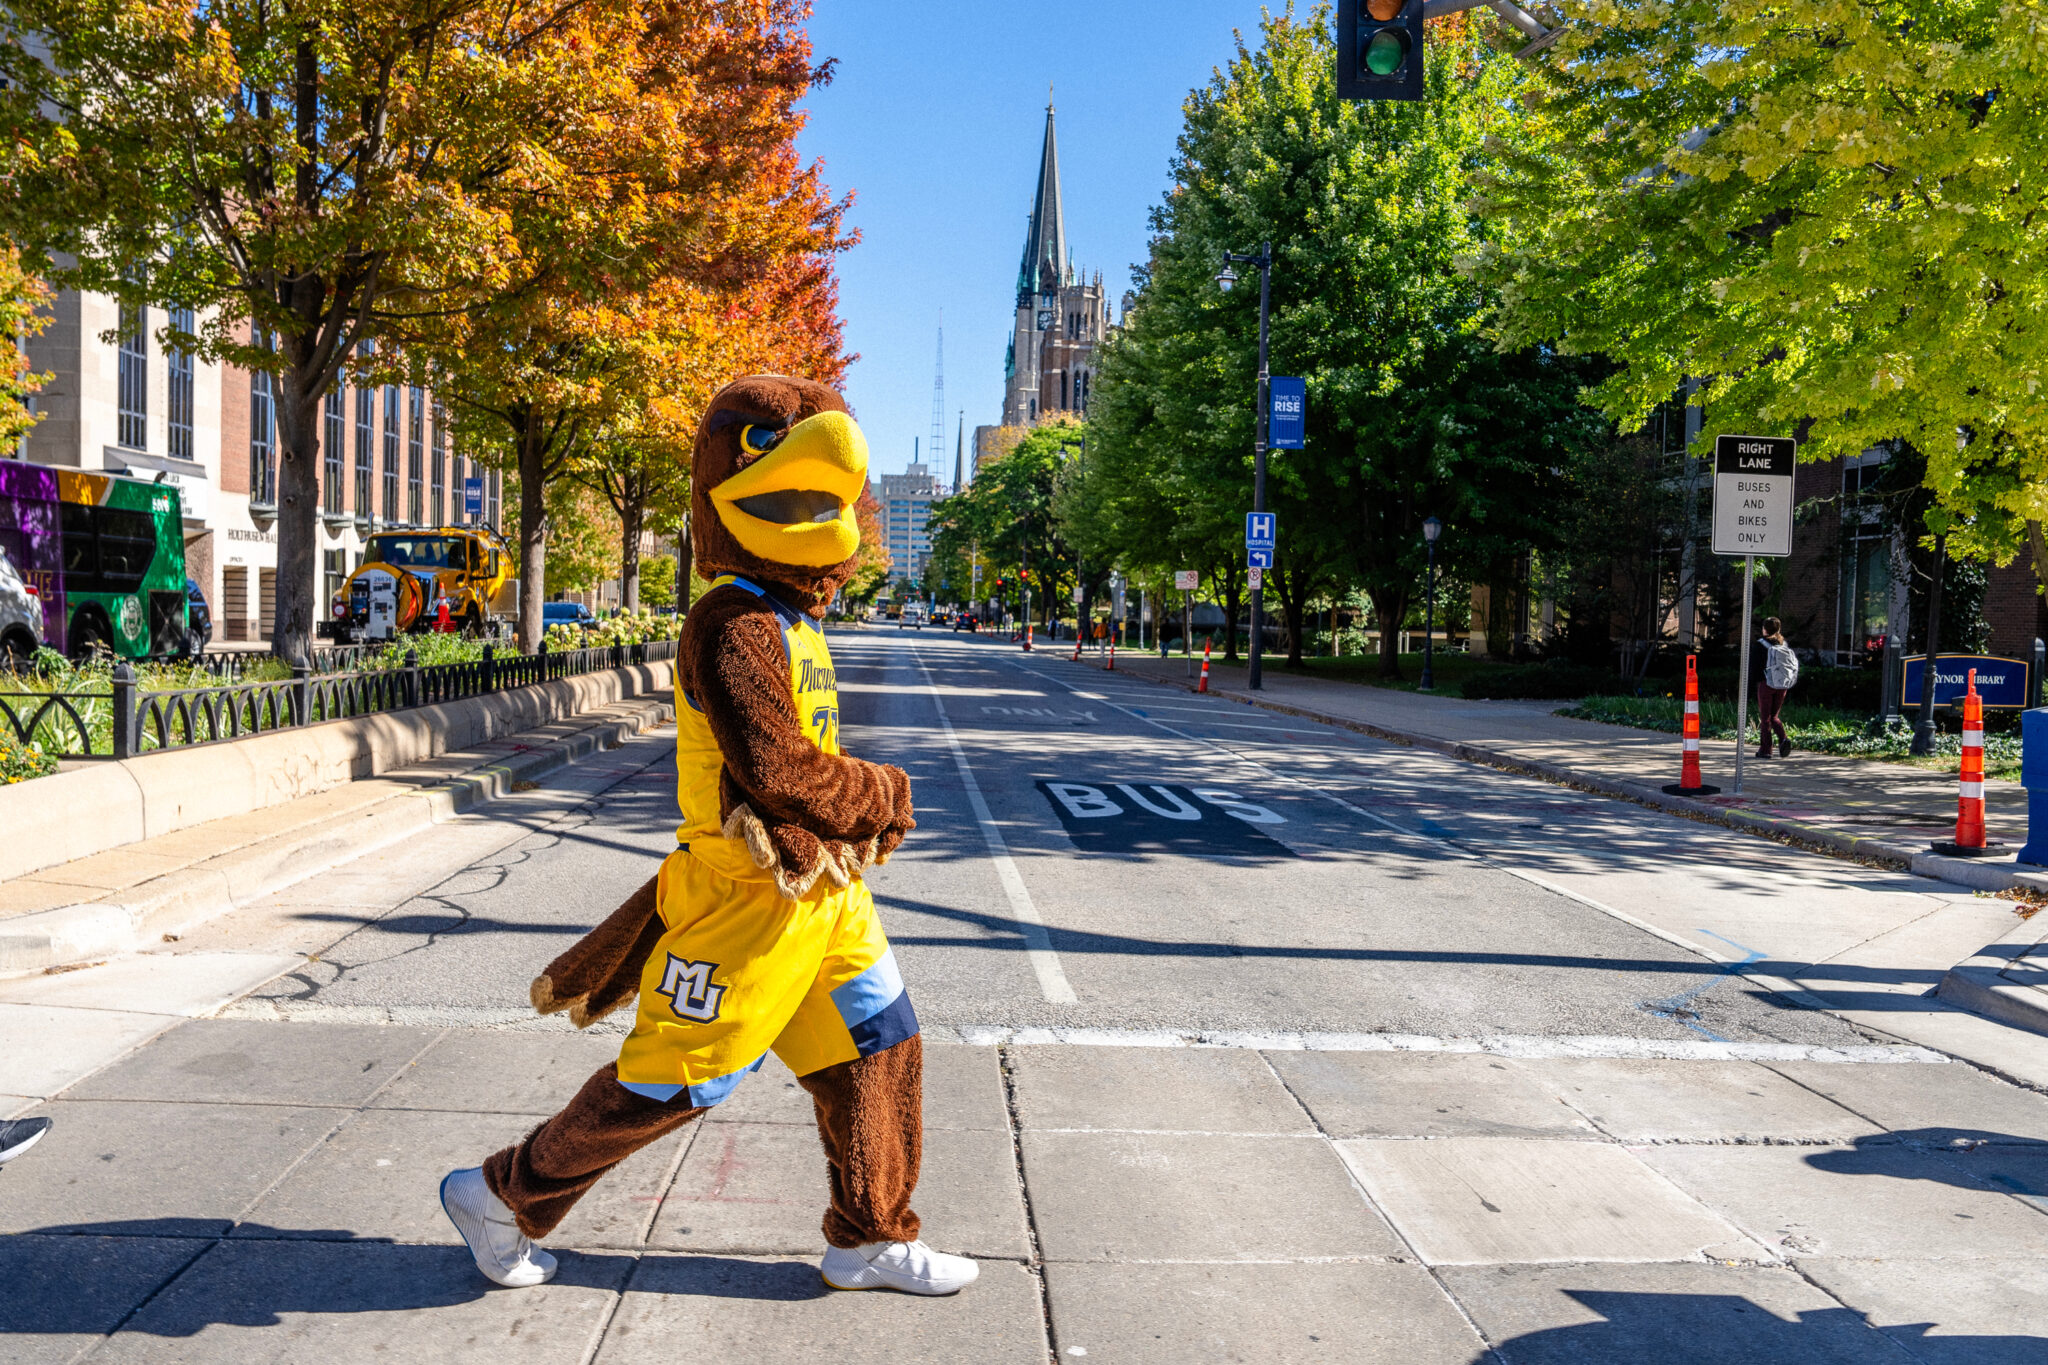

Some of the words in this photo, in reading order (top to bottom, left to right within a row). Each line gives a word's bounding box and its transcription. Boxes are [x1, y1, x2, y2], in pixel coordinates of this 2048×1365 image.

[1274, 401, 1301, 412] RISE
[1738, 443, 1774, 455] RIGHT
[1739, 457, 1772, 469] LANE
[1737, 481, 1771, 493] BUSES
[1743, 499, 1765, 509] AND
[1738, 515, 1767, 527] BIKES
[1252, 516, 1270, 539] H
[1247, 539, 1273, 547] HOSPITAL
[1738, 533, 1766, 543] ONLY
[1934, 674, 1965, 684] AYNOR
[1968, 675, 2006, 685] IBRARY
[1045, 783, 1288, 824] BUS
[654, 950, 728, 1024] MU
